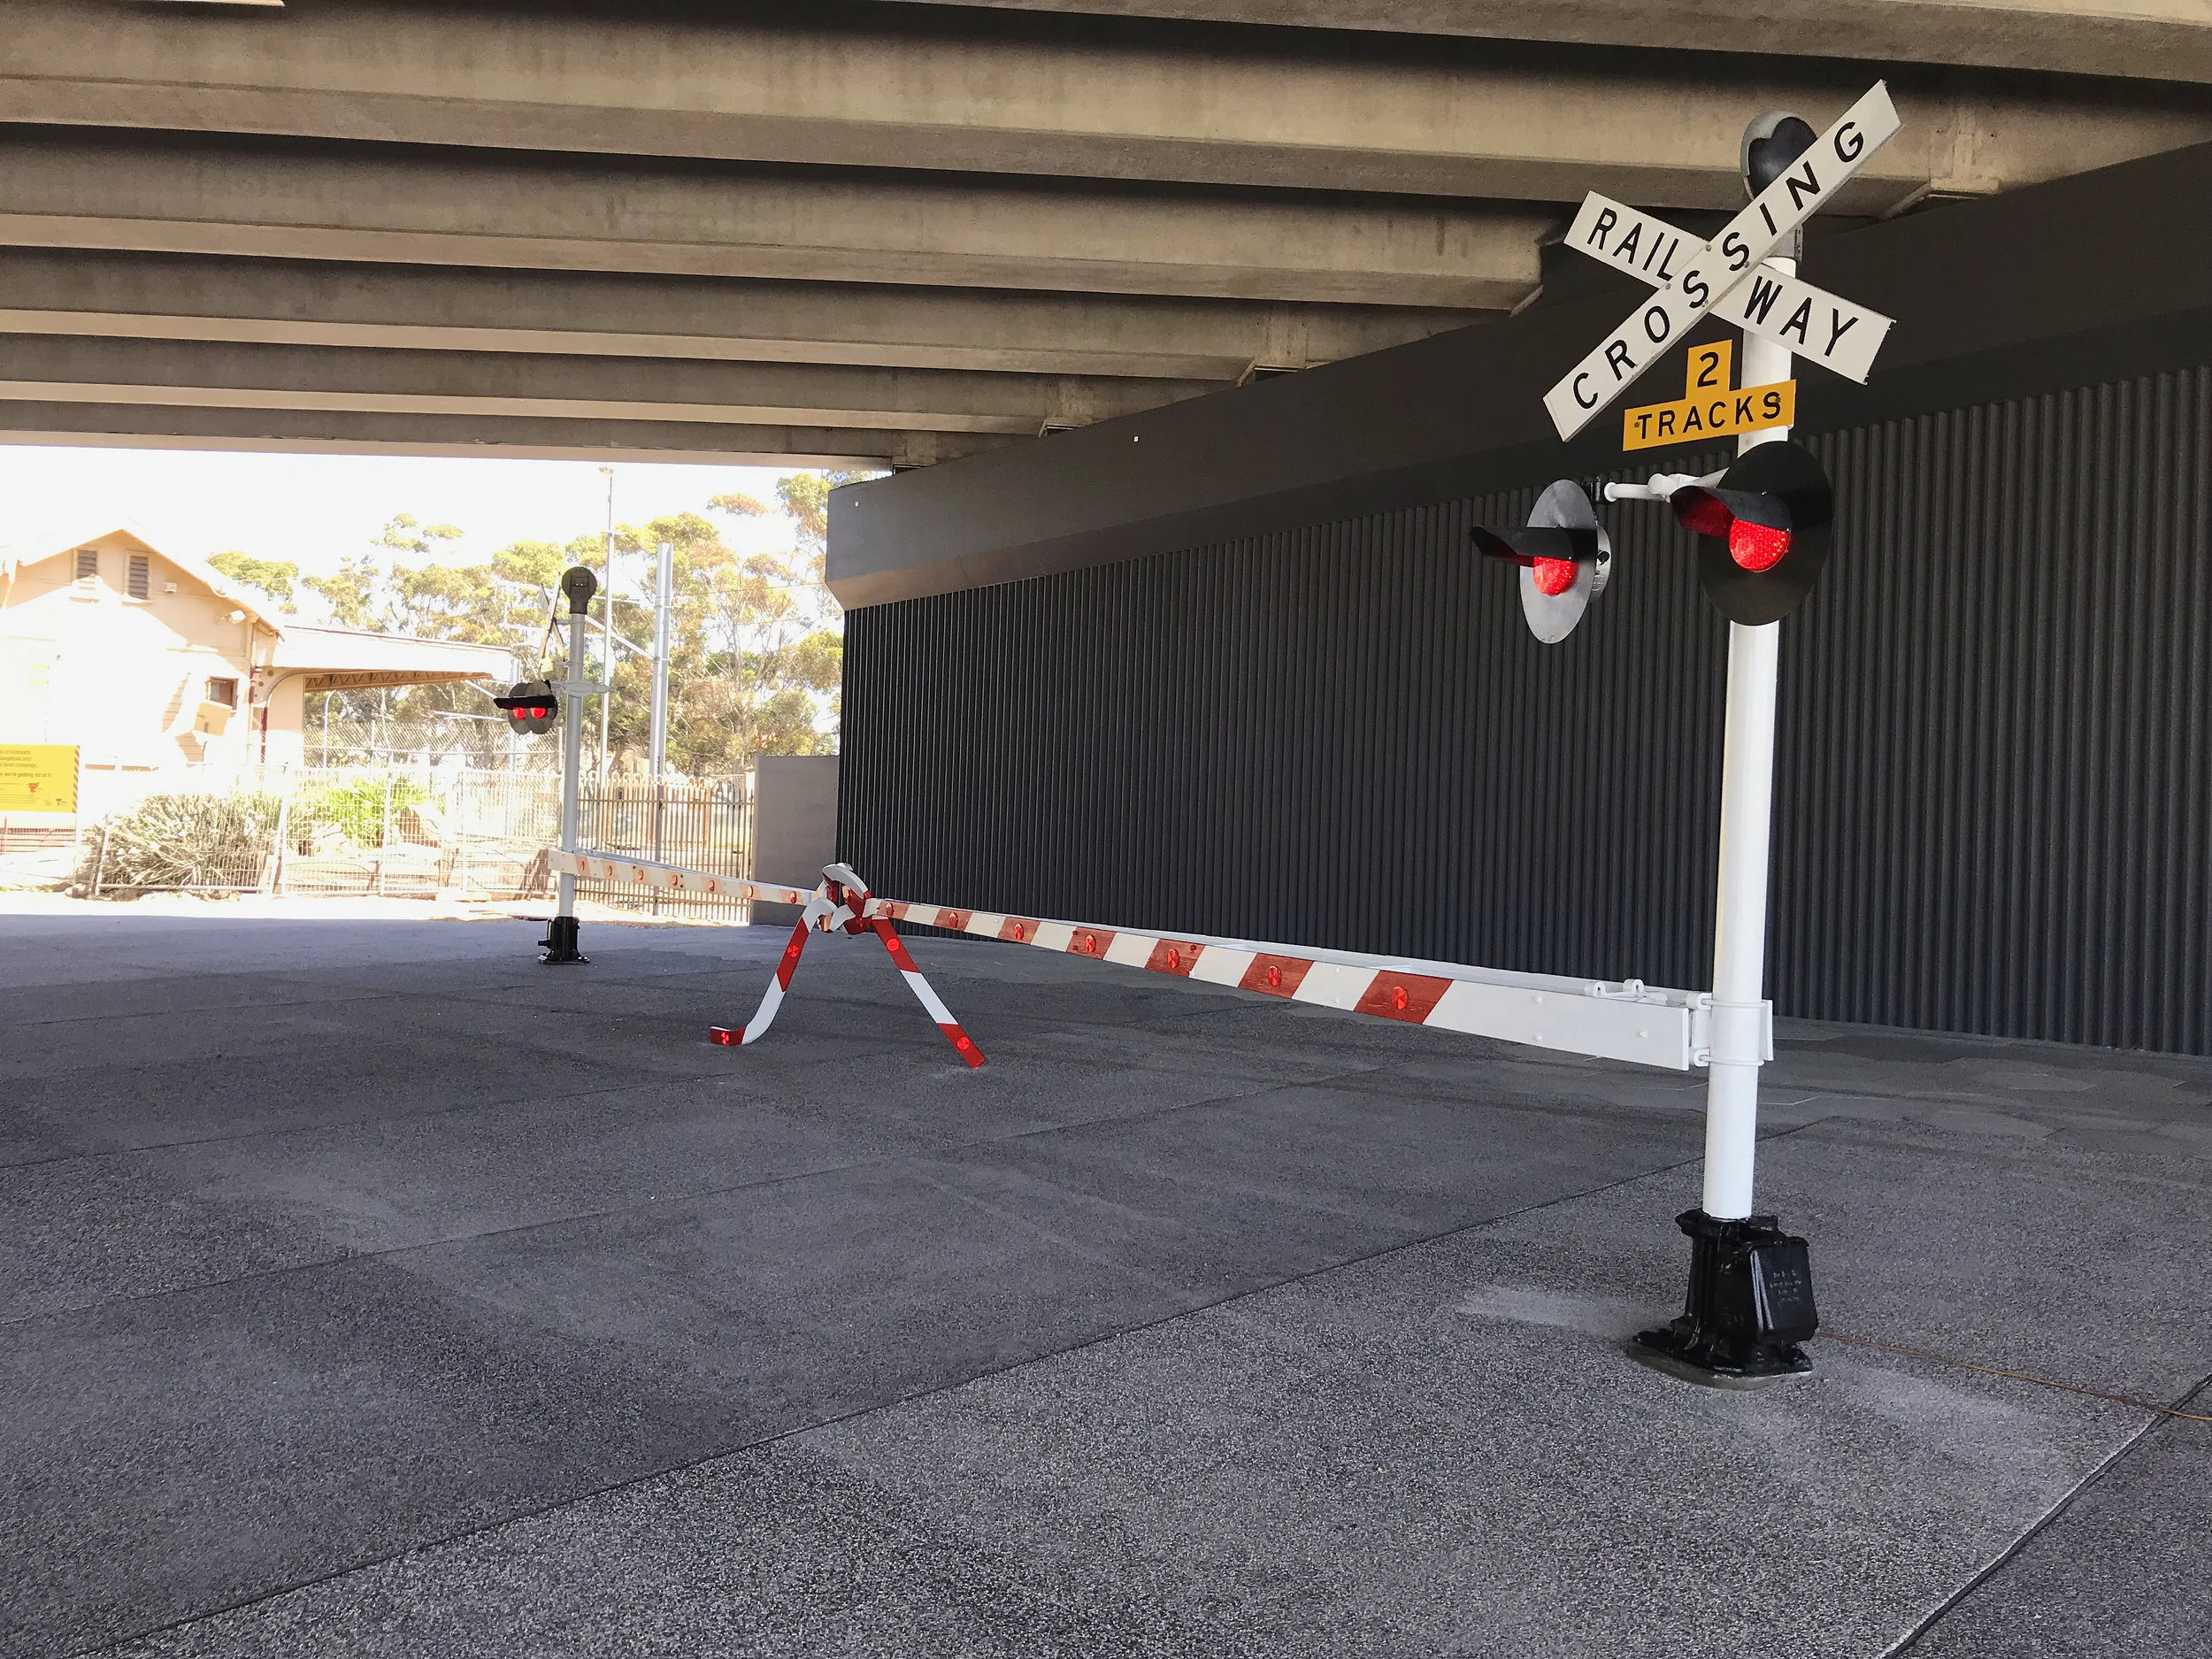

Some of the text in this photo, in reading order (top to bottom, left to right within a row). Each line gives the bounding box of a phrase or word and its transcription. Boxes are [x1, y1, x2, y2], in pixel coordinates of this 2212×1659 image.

[1573, 121, 1864, 410] CROSSING
[1587, 207, 1859, 357] RAIL WAY
[1639, 391, 1781, 440] TRACKS
[1697, 352, 1720, 388] 2
